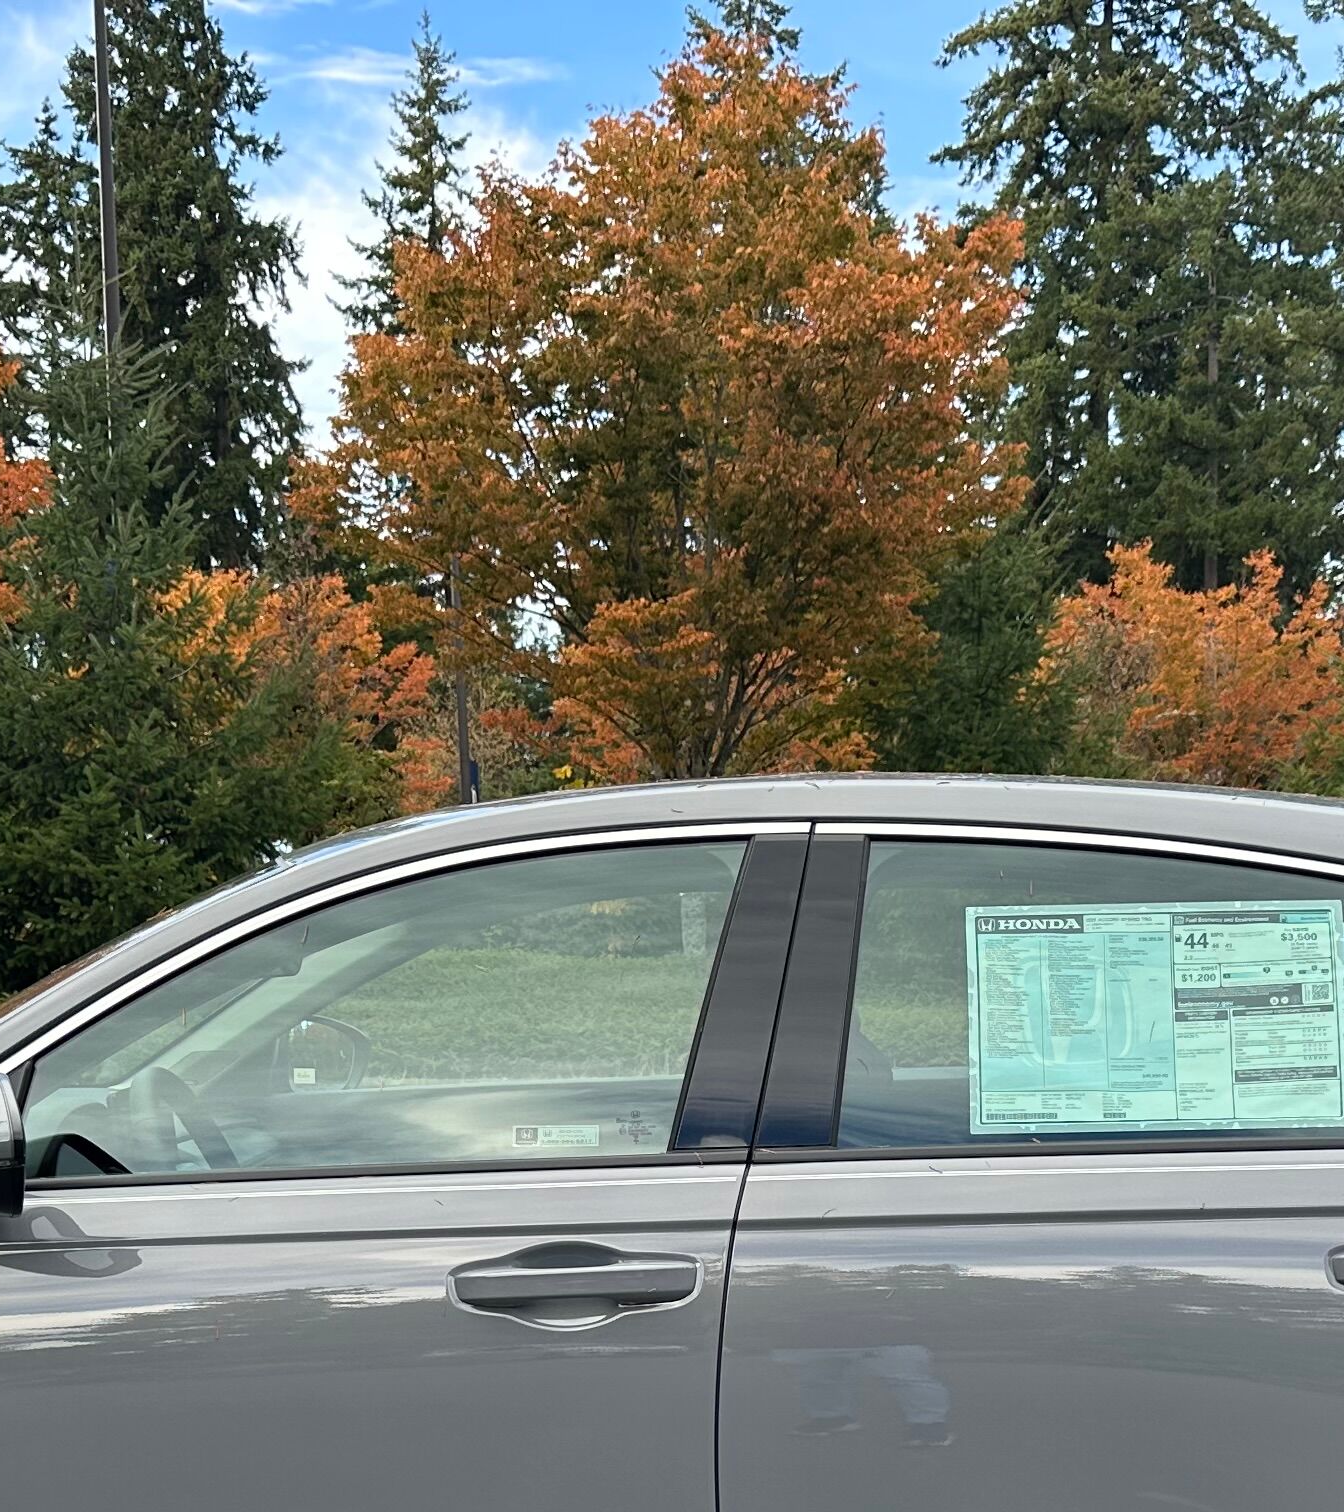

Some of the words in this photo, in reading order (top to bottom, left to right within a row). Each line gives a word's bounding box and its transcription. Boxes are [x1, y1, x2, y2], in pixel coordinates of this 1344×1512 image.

[998, 918, 1081, 930] HONDA
[1184, 932, 1209, 949] 44
[1181, 973, 1216, 983] $1,200
